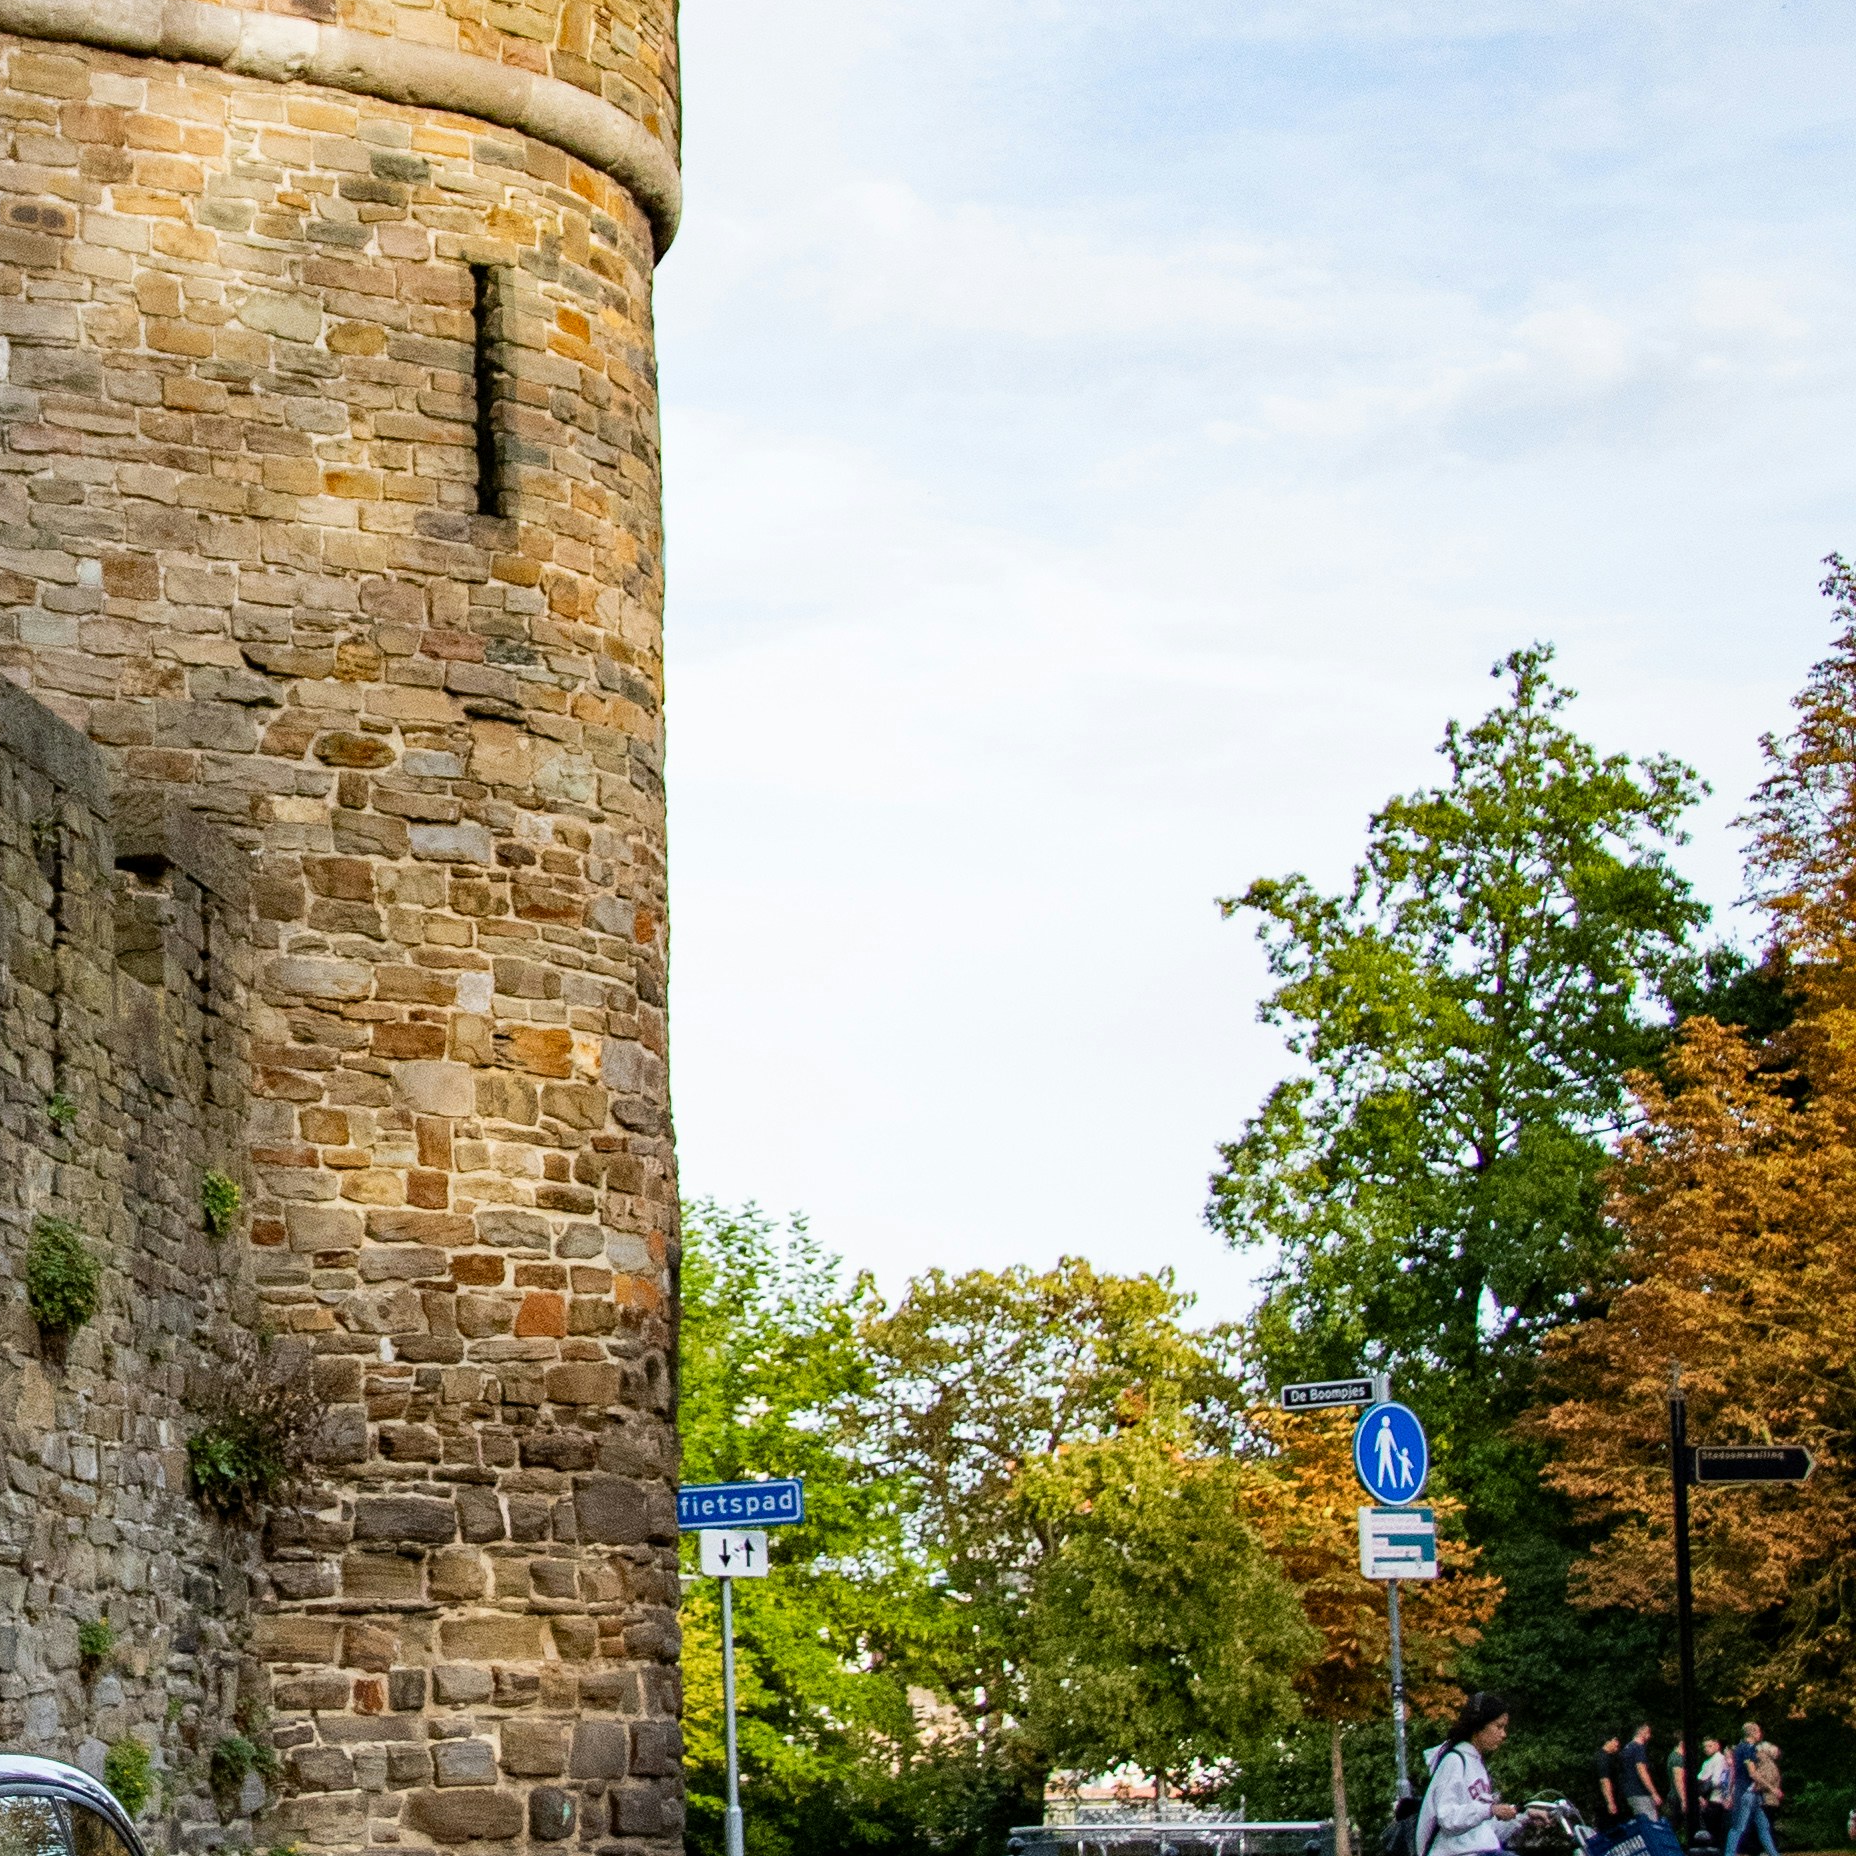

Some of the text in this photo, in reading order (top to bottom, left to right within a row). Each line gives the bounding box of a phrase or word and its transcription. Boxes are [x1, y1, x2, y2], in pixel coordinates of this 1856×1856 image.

[1290, 1385, 1365, 1402] De Boompjes
[680, 1489, 793, 1516] fietspad
